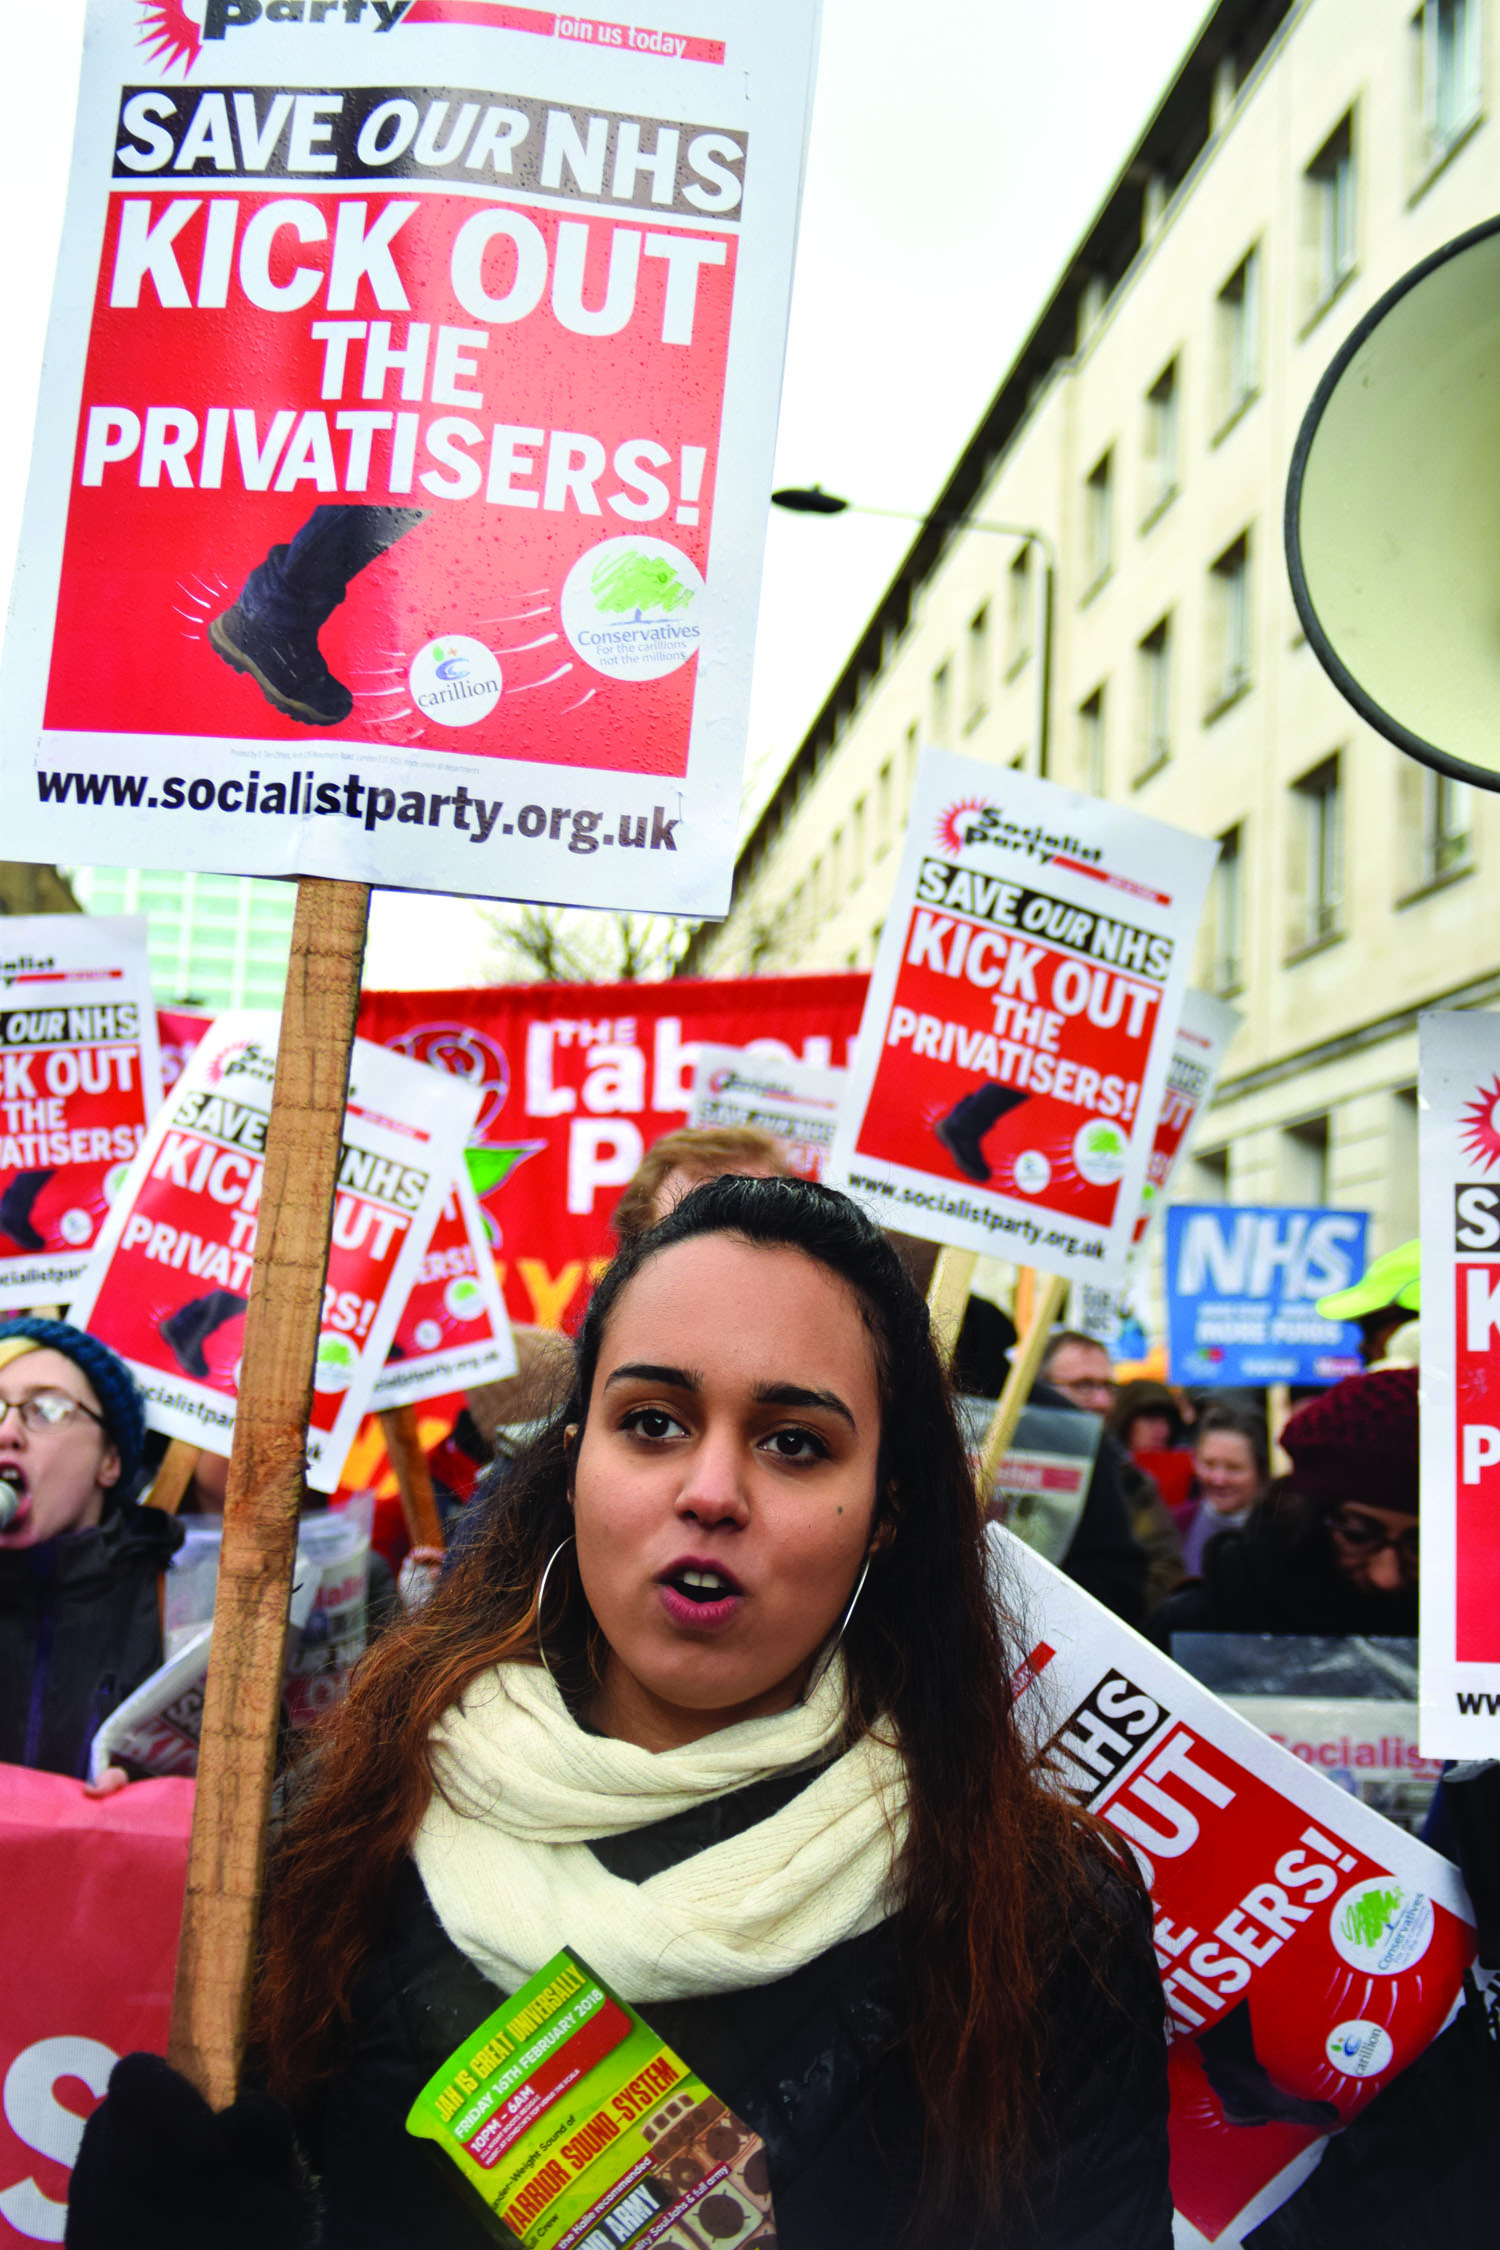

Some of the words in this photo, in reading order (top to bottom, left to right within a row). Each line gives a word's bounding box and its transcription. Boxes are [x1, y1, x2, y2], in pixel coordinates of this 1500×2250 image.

[554, 14, 593, 39] join
[597, 25, 623, 45] us
[628, 27, 687, 58] today
[117, 92, 343, 172] SAVE
[357, 99, 531, 175] OUR
[540, 110, 745, 212] NHS
[110, 200, 422, 313] KICK
[451, 209, 727, 346] OUT
[311, 322, 489, 410] THE
[81, 407, 707, 525] PRIVATISERS!
[578, 623, 700, 646] Conservatives
[596, 644, 616, 655] For
[618, 643, 635, 654] the
[599, 657, 618, 665] not
[621, 655, 640, 665] the
[642, 650, 688, 663] millions
[418, 679, 499, 707] carillion
[37, 770, 680, 855] www.socialistparty.org.uk
[979, 806, 1103, 862] Socialist
[918, 861, 1023, 925] SAVE
[1022, 897, 1094, 947] OUR
[1091, 918, 1173, 979] NHS
[906, 909, 1050, 1003] KICK
[1051, 947, 1159, 1038] OUT
[7, 1011, 66, 1044] OUR
[68, 1005, 138, 1041] NHS
[551, 1018, 637, 1046] THE
[990, 994, 1066, 1052] THE
[45, 1046, 137, 1097] OUT
[886, 1005, 1141, 1121] PRIVATISERS!
[1, 1097, 67, 1133] THE
[176, 1092, 269, 1149] SAVE
[339, 1148, 428, 1209] NHS
[331, 1195, 409, 1261] UT
[847, 1170, 1106, 1261] www.socialistparty.org.uk
[1176, 1212, 1359, 1300] NHS
[1029, 1679, 1160, 1808] NHS
[1378, 1893, 1424, 1970] Conservatives
[435, 2084, 465, 2122] JAH
[454, 2069, 479, 2095] IS
[469, 2031, 516, 2080] GREAT
[506, 1964, 587, 2043] UNIVERSALLY
[454, 2092, 494, 2138] FRIDAY
[492, 2065, 523, 2095] 16TH
[518, 2013, 577, 2069] FEBRUARY
[574, 1989, 604, 2018] 2018
[1355, 2027, 1382, 2077] carillion
[470, 2118, 502, 2152] 10PM
[507, 2085, 535, 2114] 6AM
[538, 2123, 567, 2152] Sound
[564, 2113, 577, 2126] of
[560, 2056, 679, 2171] SOUND-SYSTEM
[557, 2232, 575, 2250] the
[594, 2155, 652, 2214] recommended
[604, 2183, 660, 2243] ARMY
[685, 2194, 695, 2204] &
[692, 2182, 707, 2198] full
[706, 2164, 729, 2188] army
[537, 2214, 558, 2237] Crew
